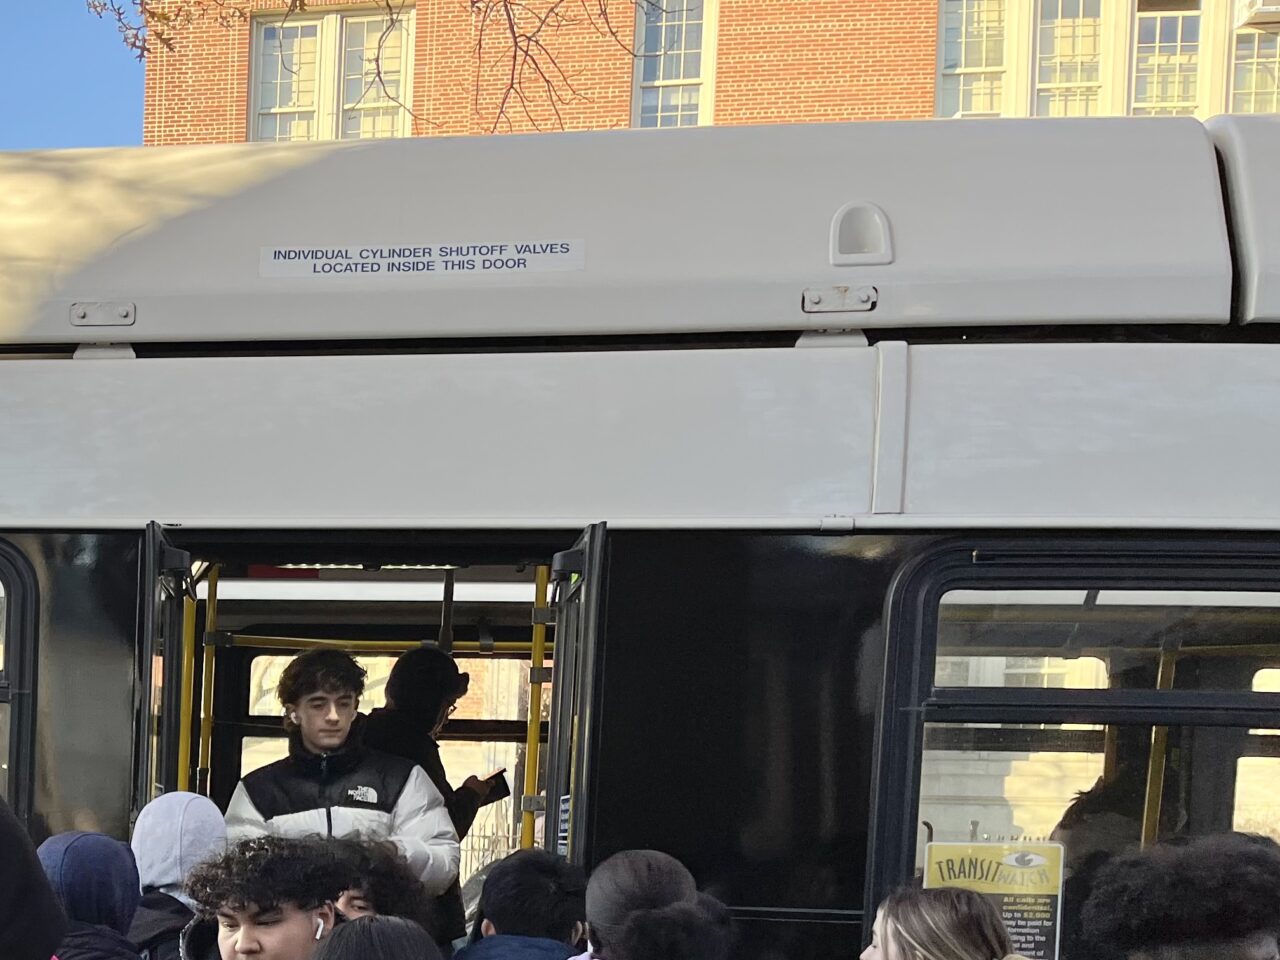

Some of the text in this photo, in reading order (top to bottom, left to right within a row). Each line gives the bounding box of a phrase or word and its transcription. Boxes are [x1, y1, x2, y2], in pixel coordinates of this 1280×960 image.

[273, 242, 570, 260] INDIVIDUAL CYLINDER SHUTOFF VALVES
[312, 258, 527, 274] LOCATED INSIDE THIS DOOR
[935, 857, 1050, 887] TRANSIT WATCH
